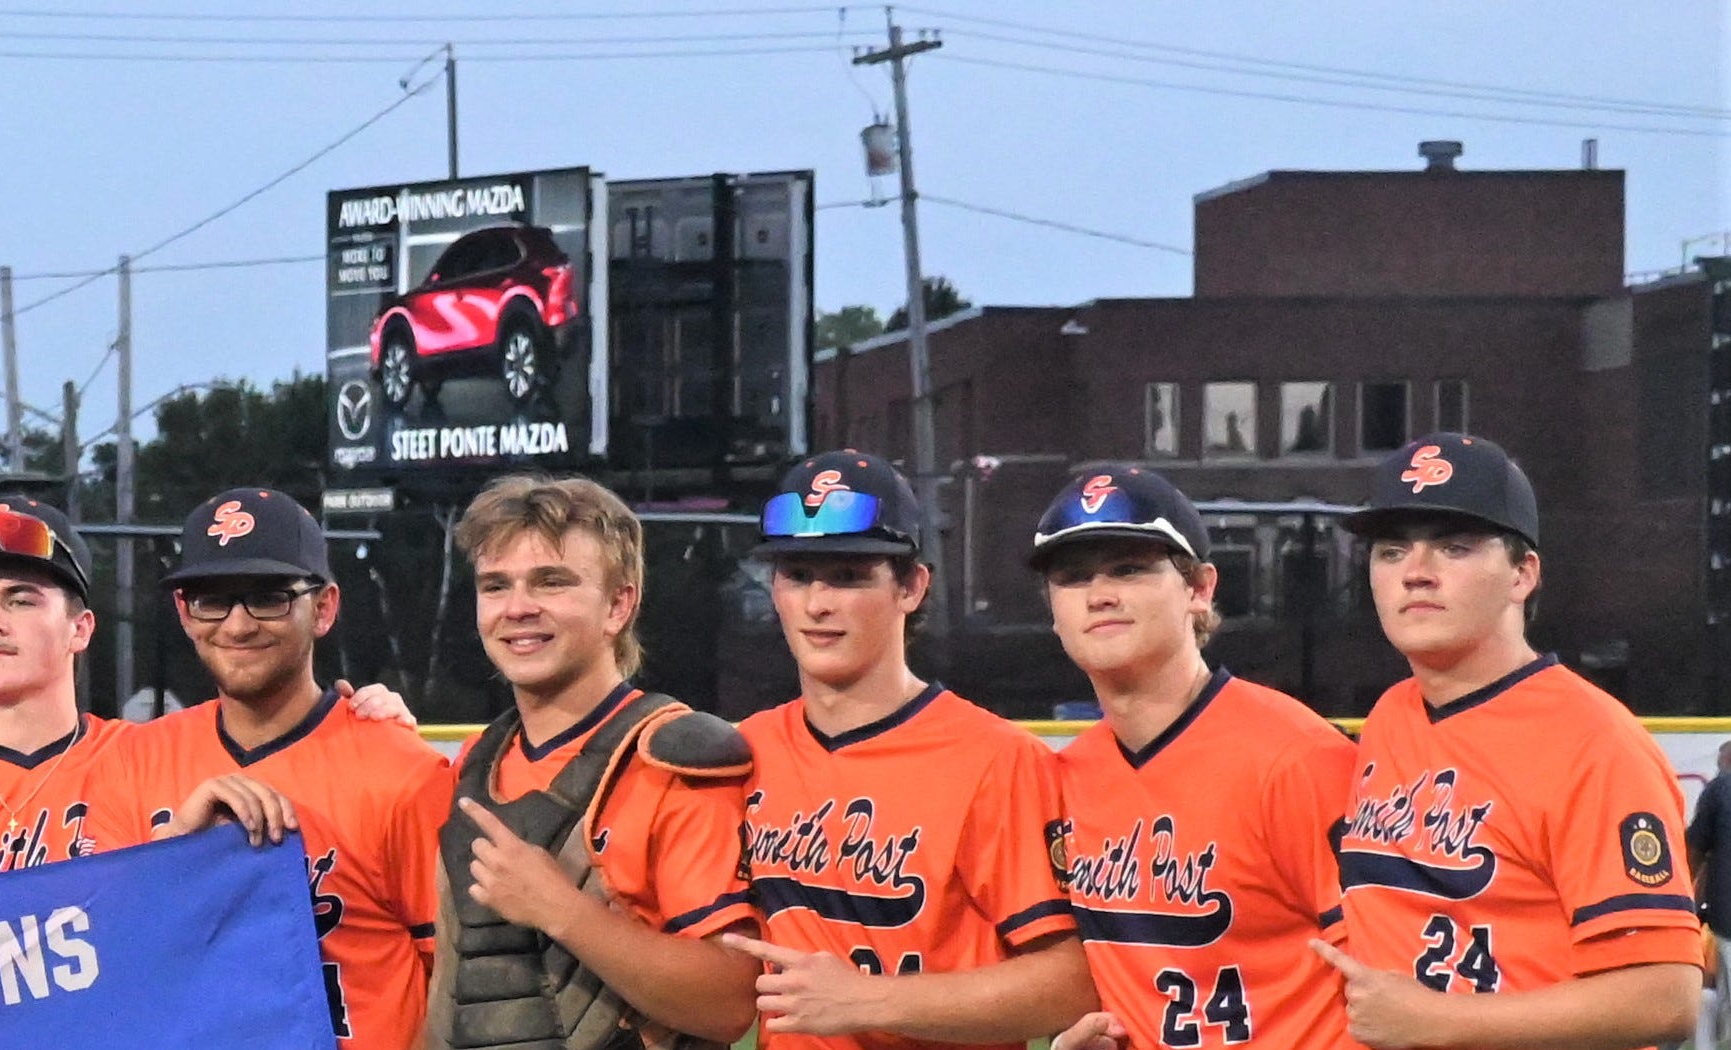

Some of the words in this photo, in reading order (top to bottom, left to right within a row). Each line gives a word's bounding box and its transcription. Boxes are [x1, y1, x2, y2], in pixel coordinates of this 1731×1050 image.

[339, 187, 465, 227] AWARD-WINNING
[466, 184, 526, 216] MAZDA
[391, 428, 437, 461] STEET
[440, 425, 497, 459] PONTE
[500, 422, 569, 456] MAZDA
[837, 796, 923, 889] Post
[1424, 768, 1494, 859] Post
[1152, 814, 1219, 907] Post
[1413, 913, 1501, 994] 24
[1155, 963, 1253, 1049] 24
